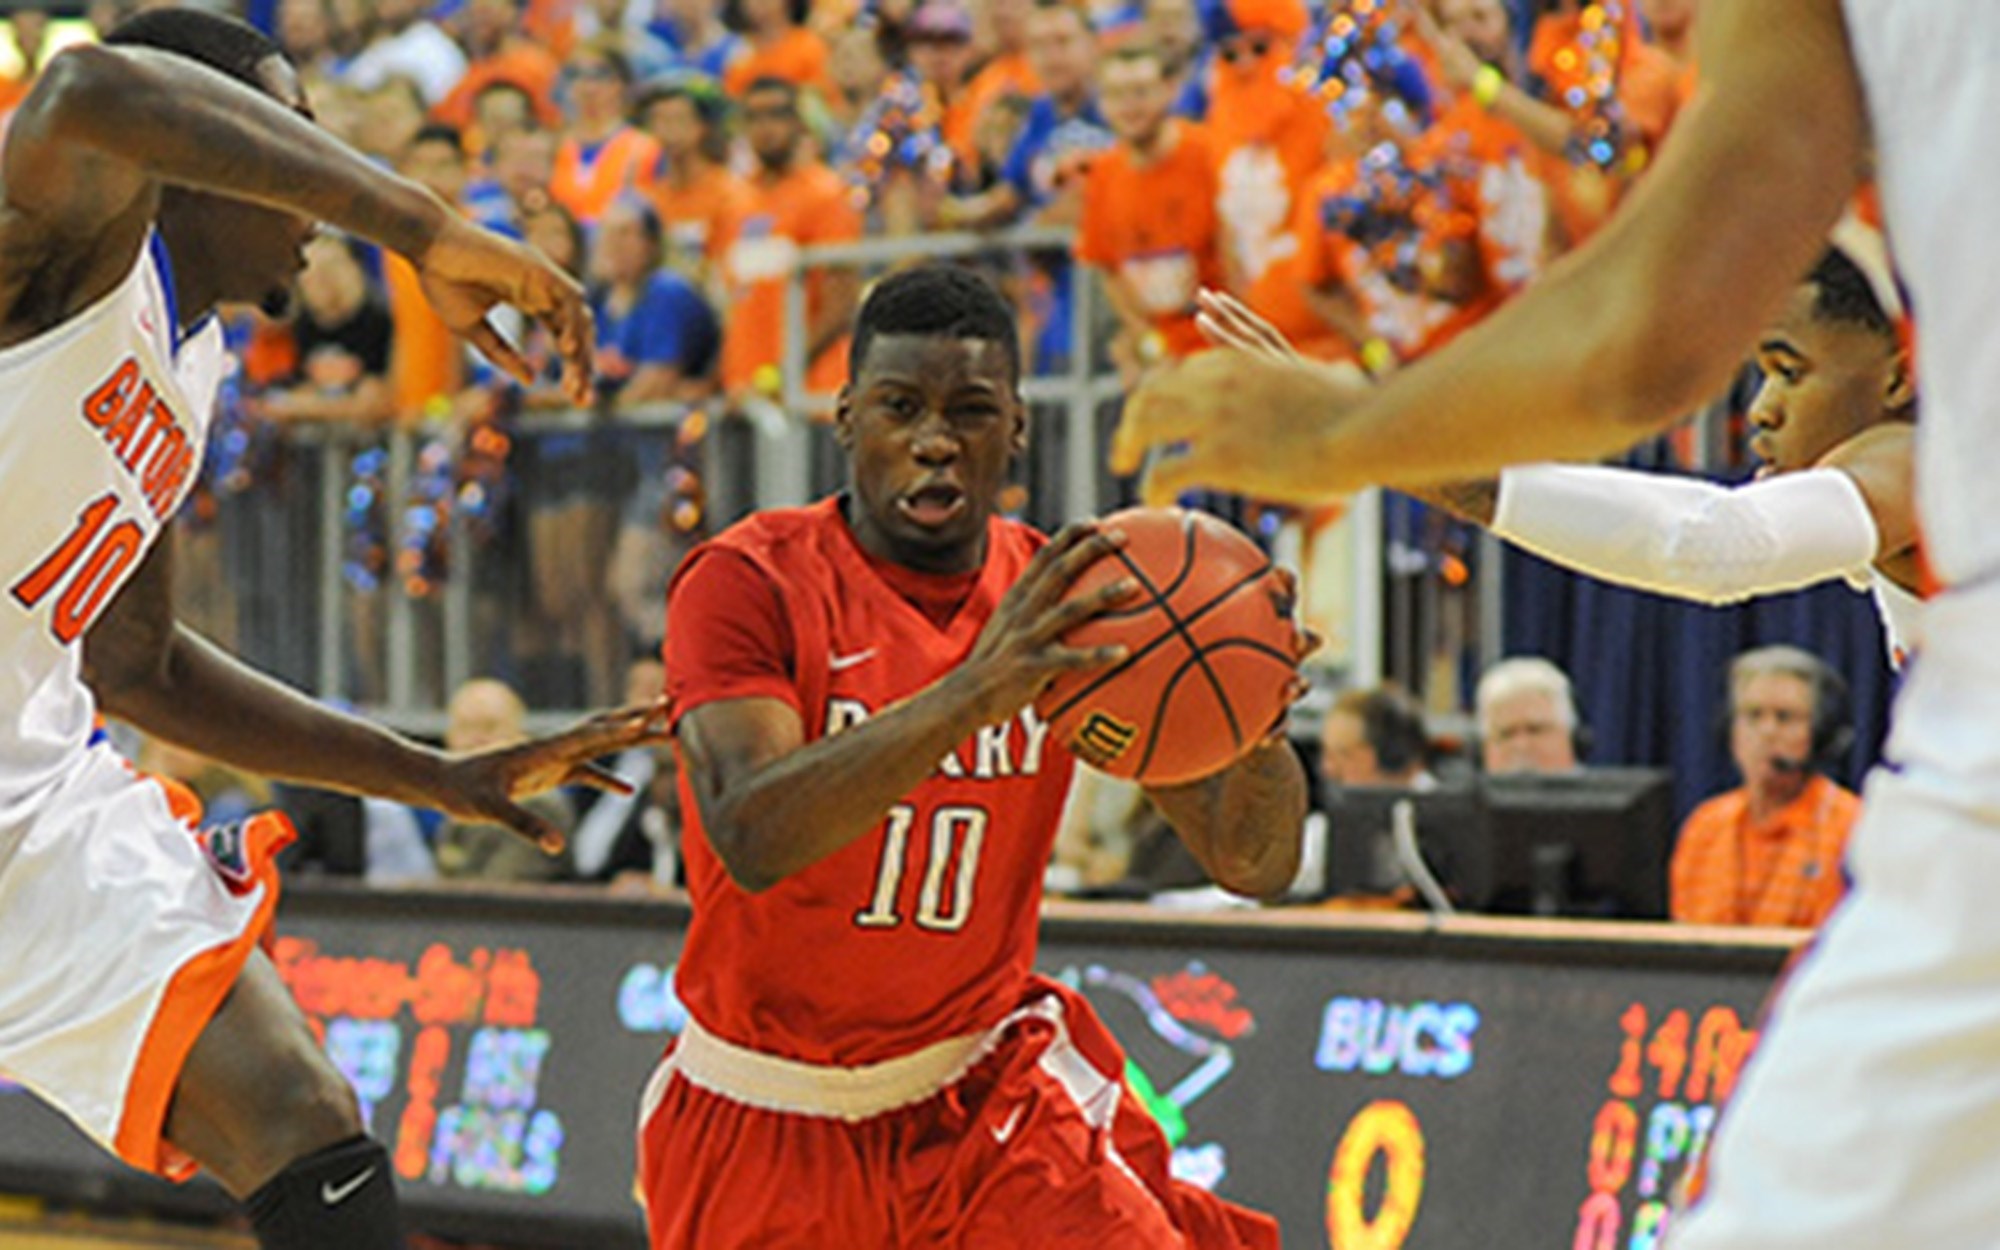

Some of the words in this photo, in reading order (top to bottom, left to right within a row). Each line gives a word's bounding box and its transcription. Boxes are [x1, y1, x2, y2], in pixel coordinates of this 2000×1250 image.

[10, 491, 145, 646] 10
[853, 803, 989, 931] 10
[1314, 996, 1479, 1077] BUCS
[1326, 1099, 1425, 1250] 0
